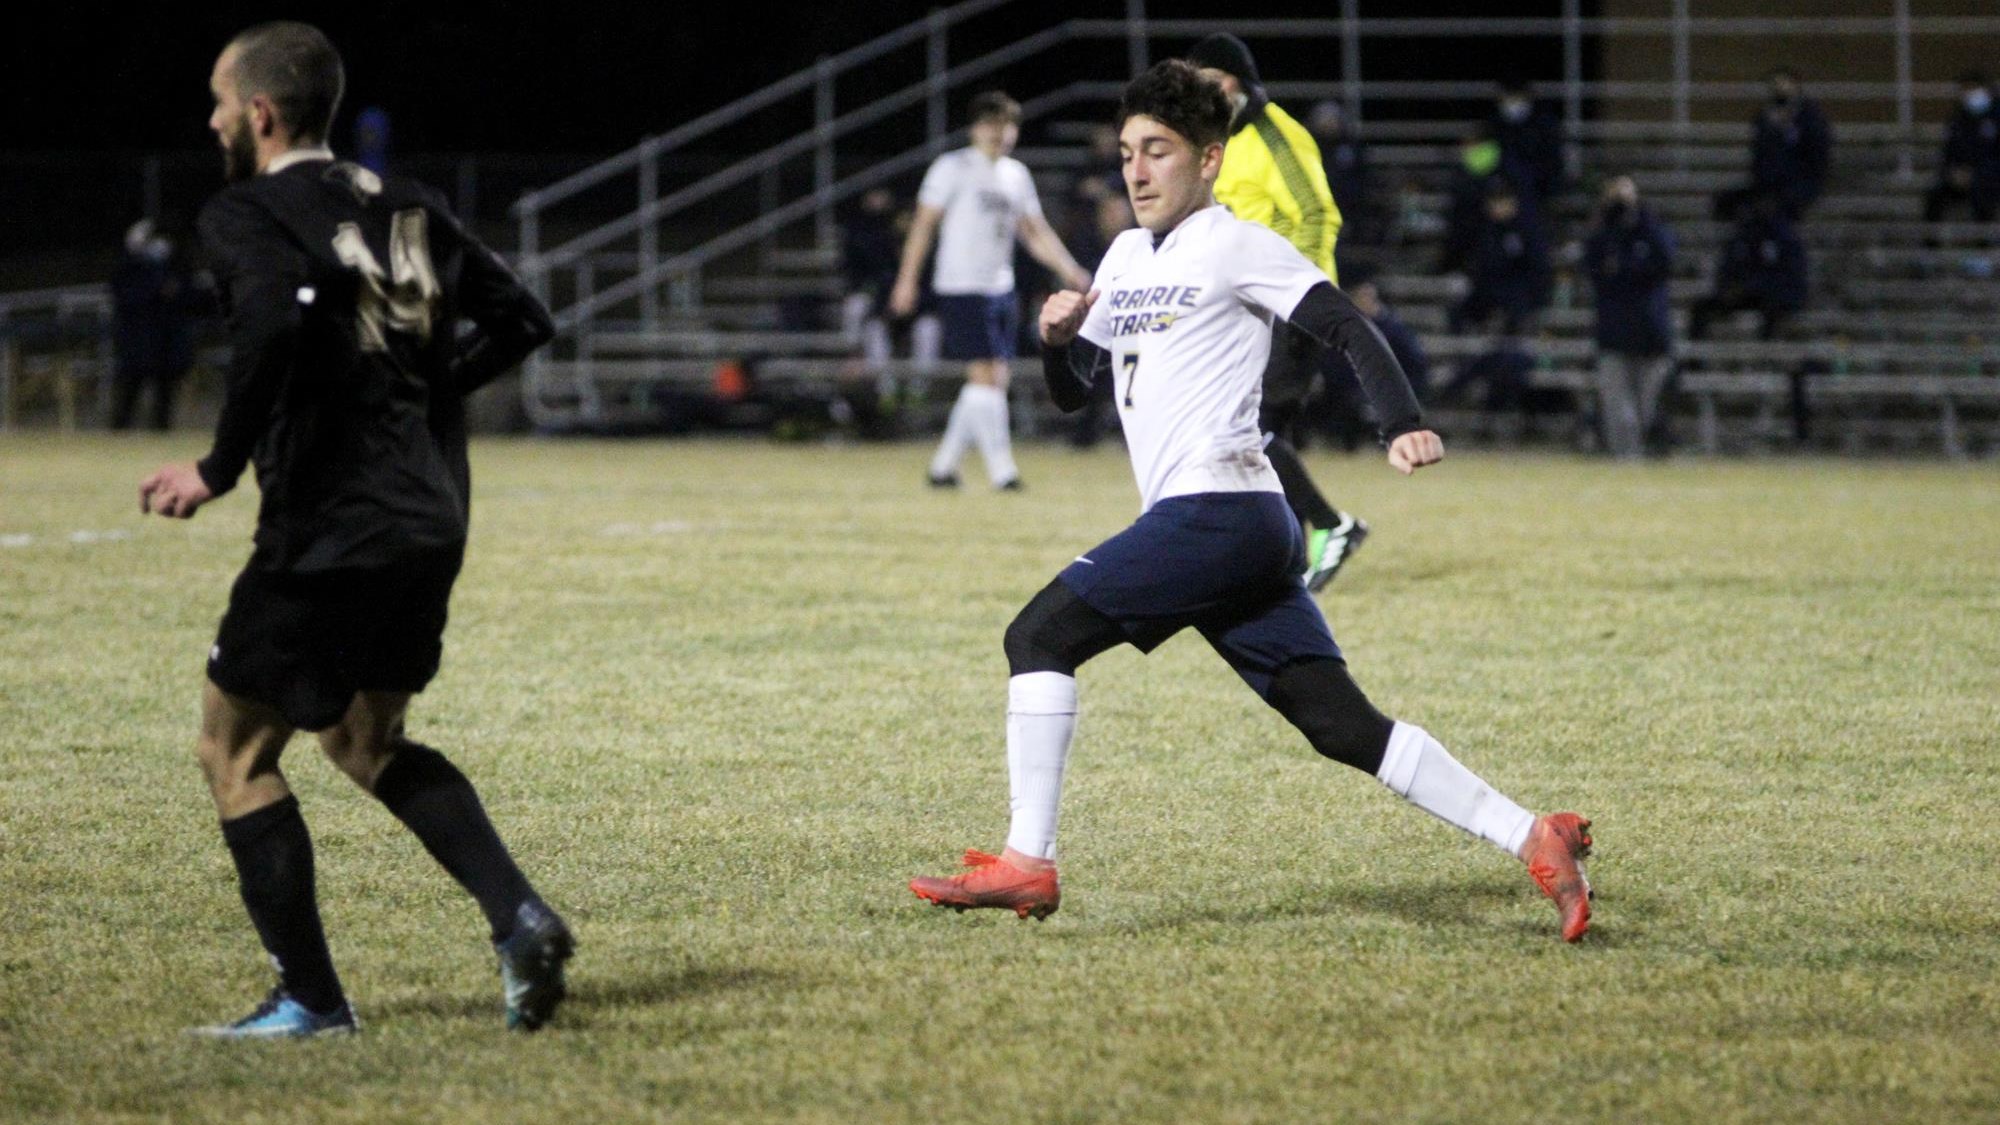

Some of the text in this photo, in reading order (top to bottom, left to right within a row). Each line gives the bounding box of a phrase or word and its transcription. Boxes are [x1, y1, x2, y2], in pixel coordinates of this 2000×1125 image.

[1110, 286, 1202, 309] RAIRIE
[1111, 311, 1170, 337] TARS
[1122, 353, 1139, 409] 7
